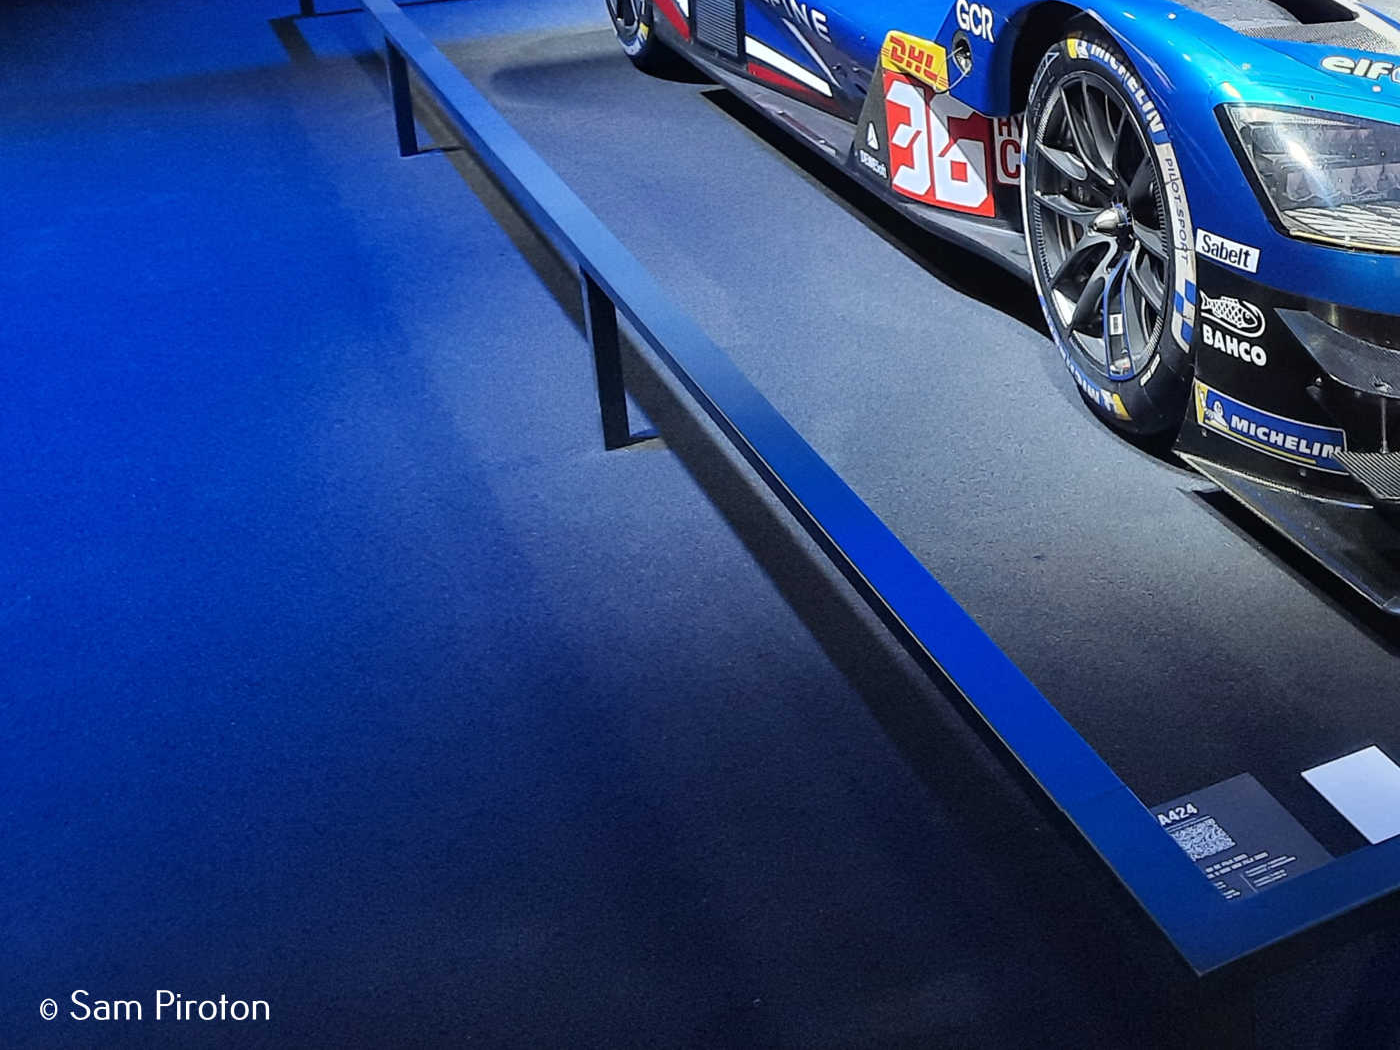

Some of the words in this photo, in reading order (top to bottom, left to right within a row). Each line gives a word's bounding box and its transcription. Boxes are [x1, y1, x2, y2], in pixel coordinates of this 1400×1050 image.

[889, 35, 938, 83] DHL
[1321, 56, 1395, 81] elf
[1091, 43, 1164, 133] MICHELIN
[885, 81, 989, 208] 36
[1164, 157, 1182, 203] PILOT
[1175, 204, 1189, 263] SPORT
[1201, 234, 1251, 268] Sabelt
[1203, 325, 1267, 367] BAHCO
[1231, 416, 1341, 459] MICHELIN
[1157, 803, 1198, 826] A424
